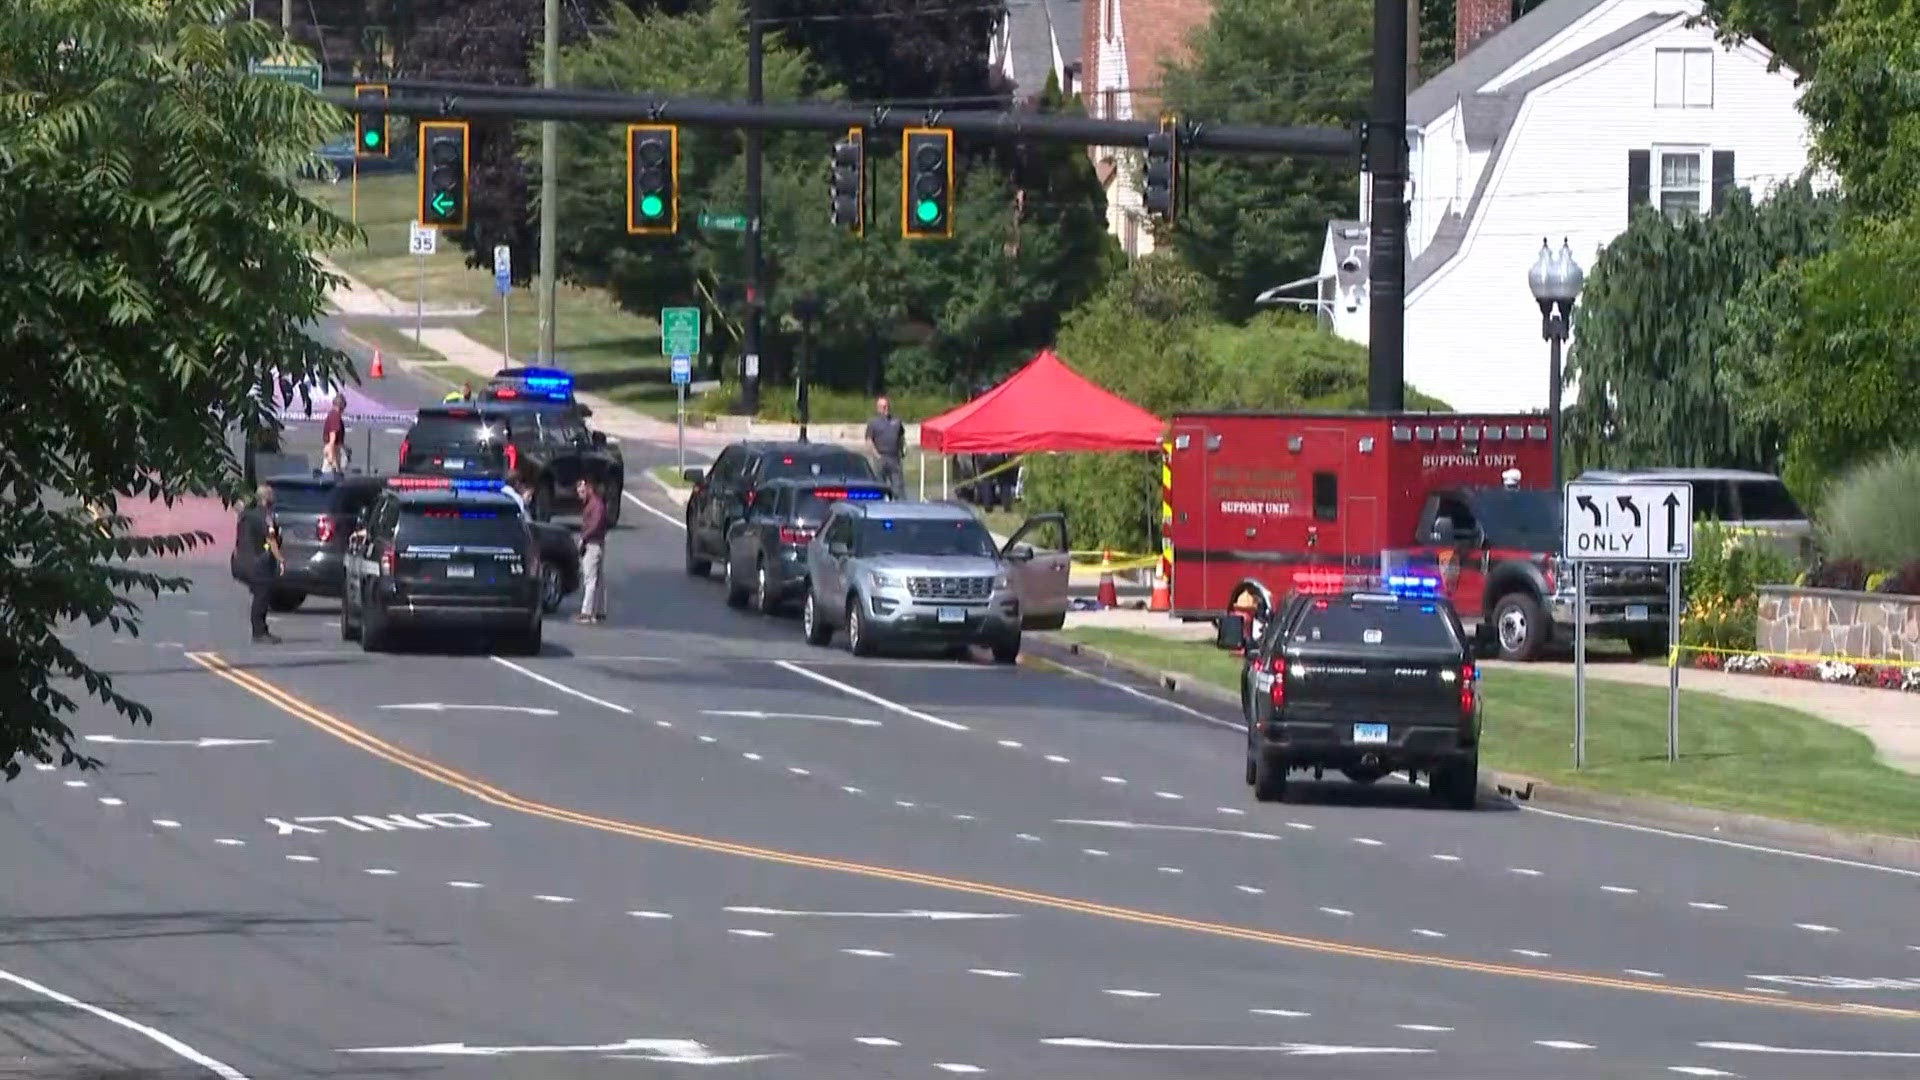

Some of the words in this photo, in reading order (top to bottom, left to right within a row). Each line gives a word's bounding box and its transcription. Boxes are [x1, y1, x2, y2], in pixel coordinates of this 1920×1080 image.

[413, 237, 432, 251] 35
[1422, 454, 1480, 467] SUPPORT
[1484, 454, 1517, 467] UNIT
[1220, 501, 1263, 515] SUPPORT
[1265, 502, 1291, 515] UNIT
[1578, 532, 1634, 552] ONLY
[264, 812, 493, 835] ONLY
